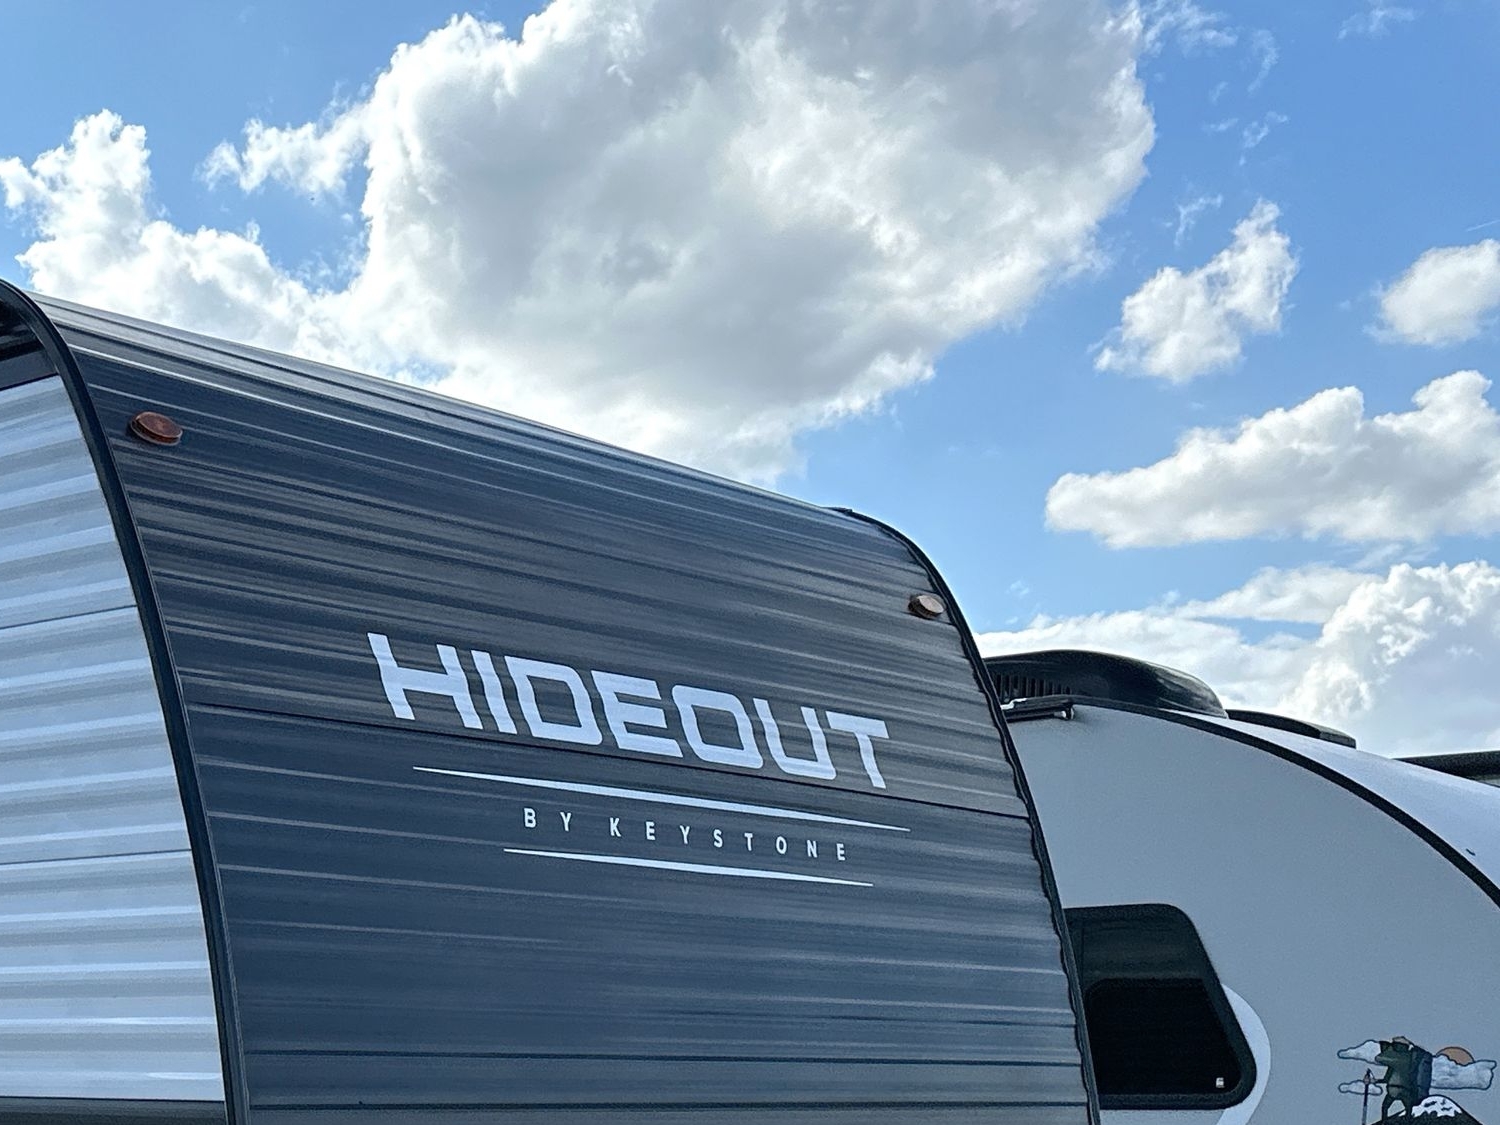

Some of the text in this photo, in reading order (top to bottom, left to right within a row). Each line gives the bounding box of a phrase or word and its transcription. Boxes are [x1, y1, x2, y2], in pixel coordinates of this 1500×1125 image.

[367, 632, 890, 790] HIDEOUT
[523, 807, 847, 862] BY KEYSTONE
